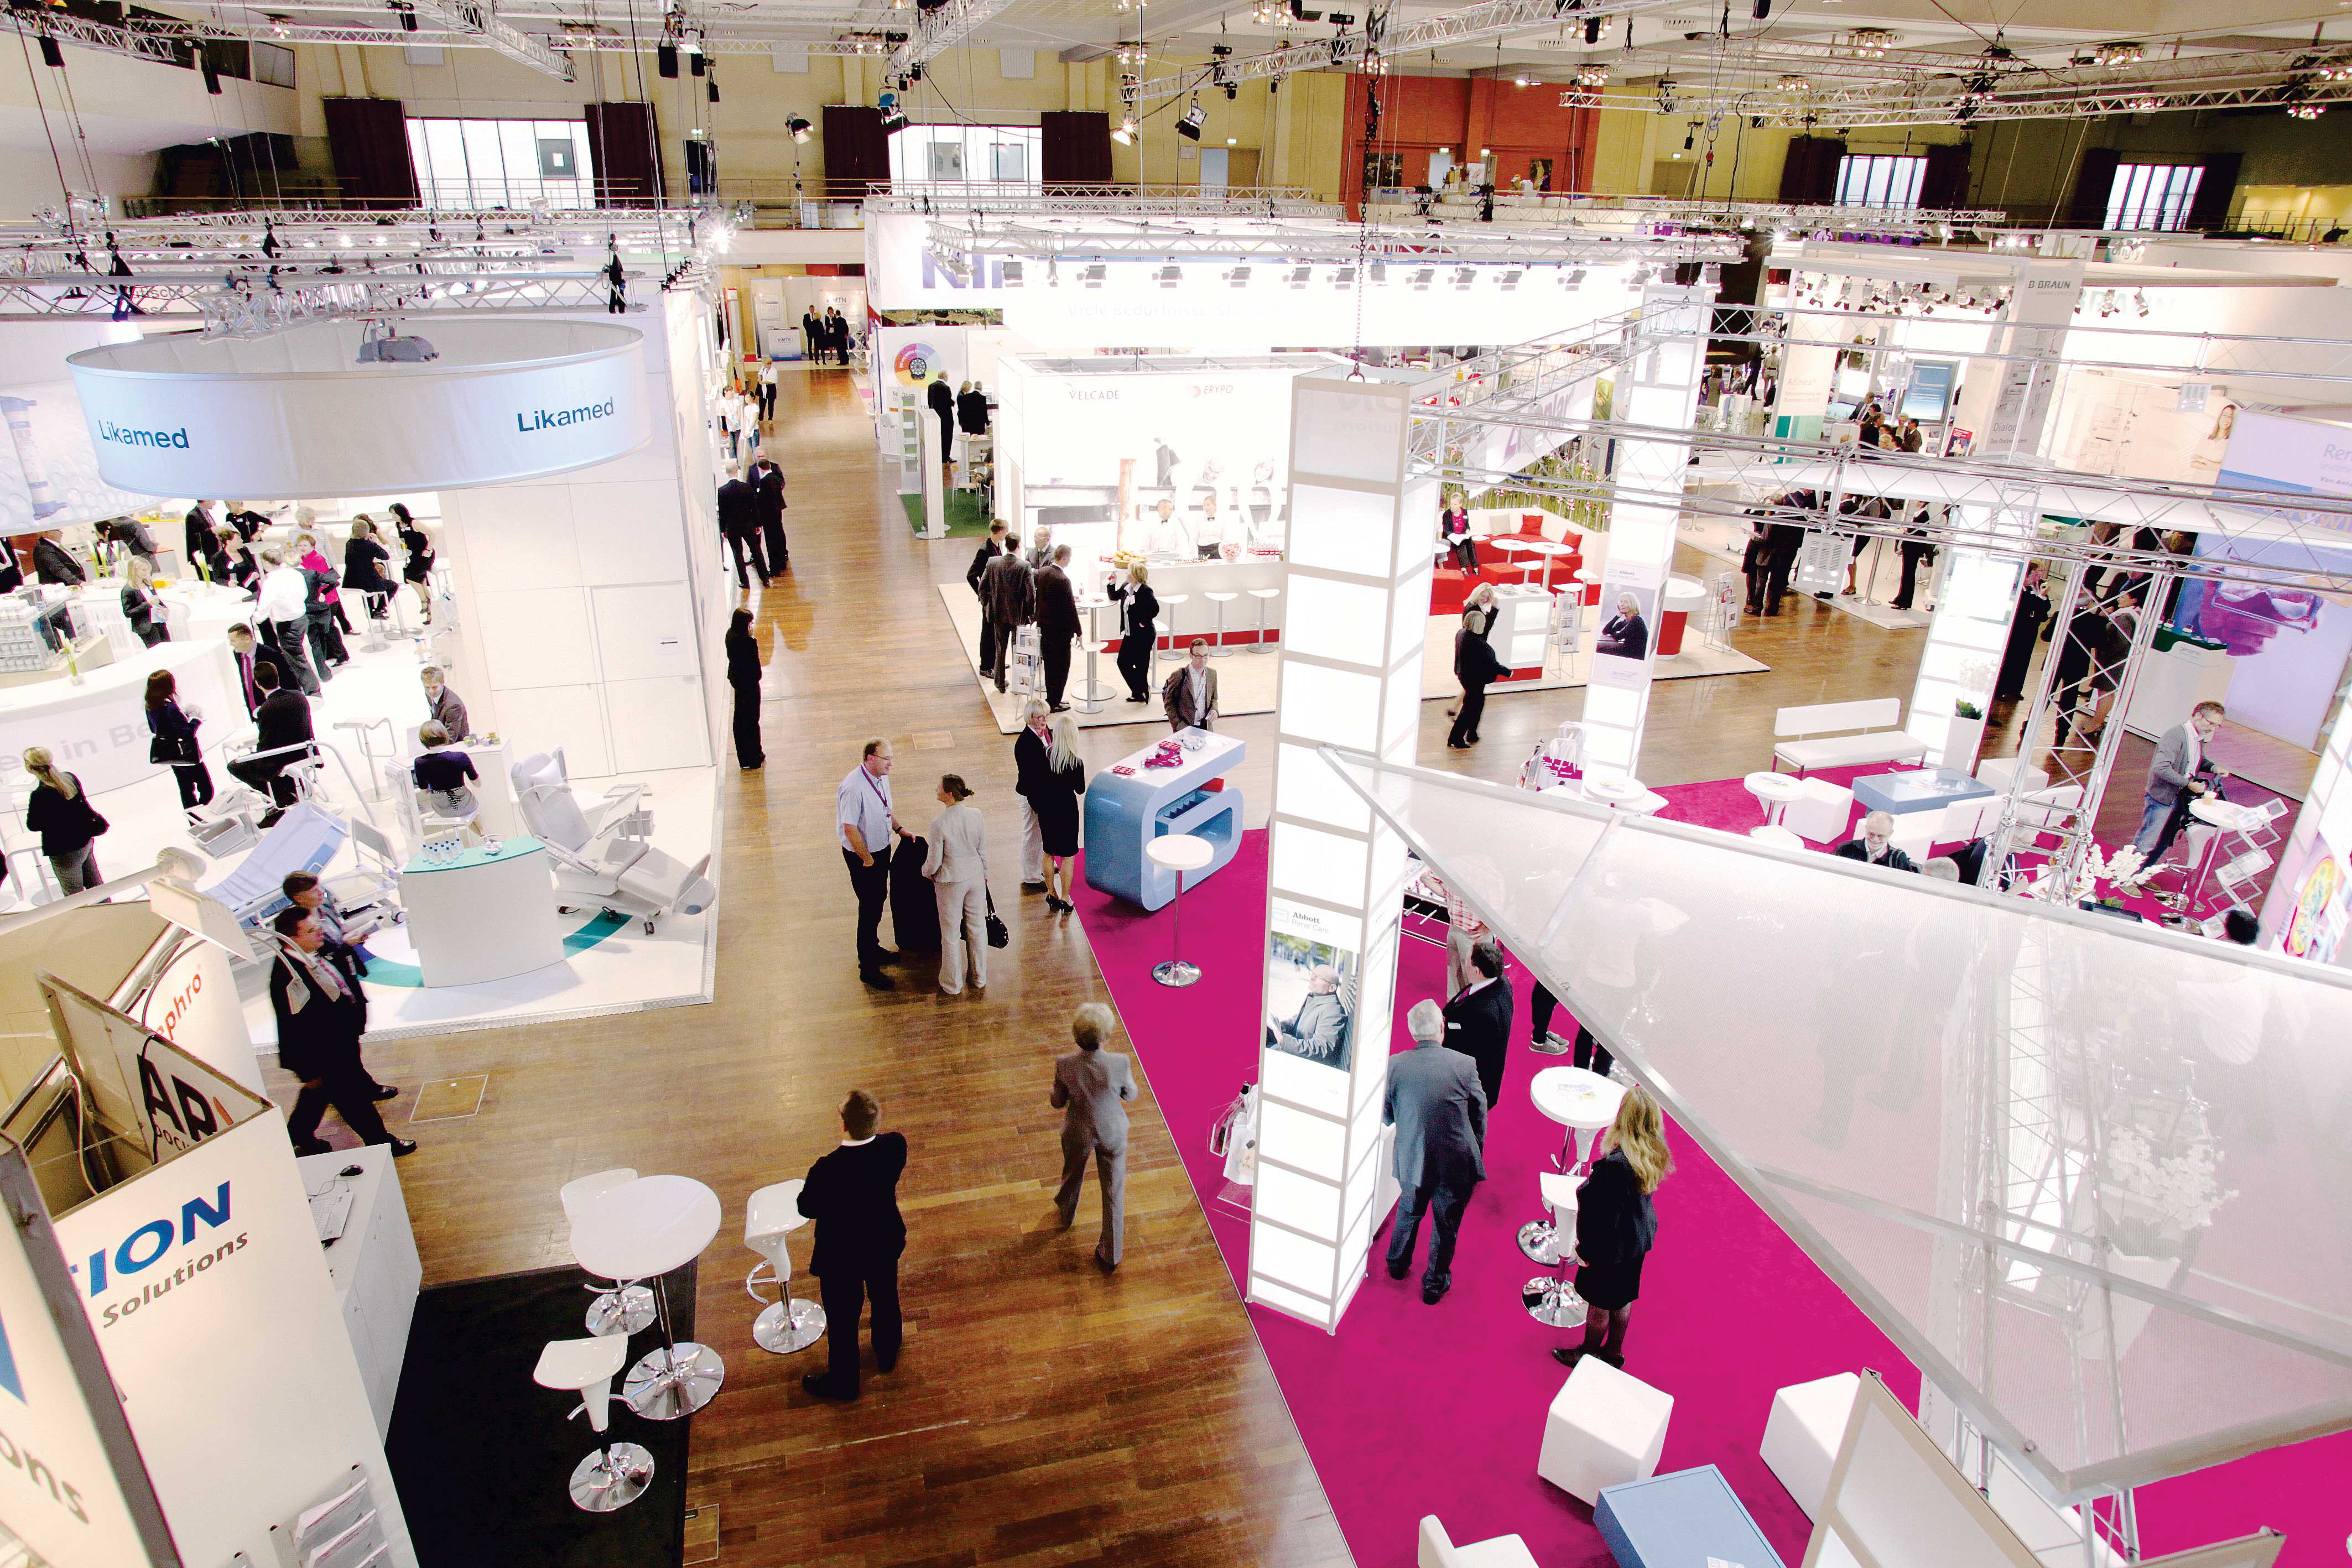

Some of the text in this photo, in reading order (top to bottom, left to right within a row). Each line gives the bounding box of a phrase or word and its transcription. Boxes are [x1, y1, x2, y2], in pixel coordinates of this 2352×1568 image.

[1069, 390, 1120, 400] VELCADE
[1204, 384, 1234, 394] ERYPO
[517, 397, 615, 433] Likamed
[98, 419, 190, 449] Likamed
[60, 738, 98, 760] in
[1291, 919, 1329, 934] Renal Care
[1292, 912, 1320, 924] Abbott
[69, 1180, 230, 1298] ION
[103, 1232, 248, 1329] Solutions
